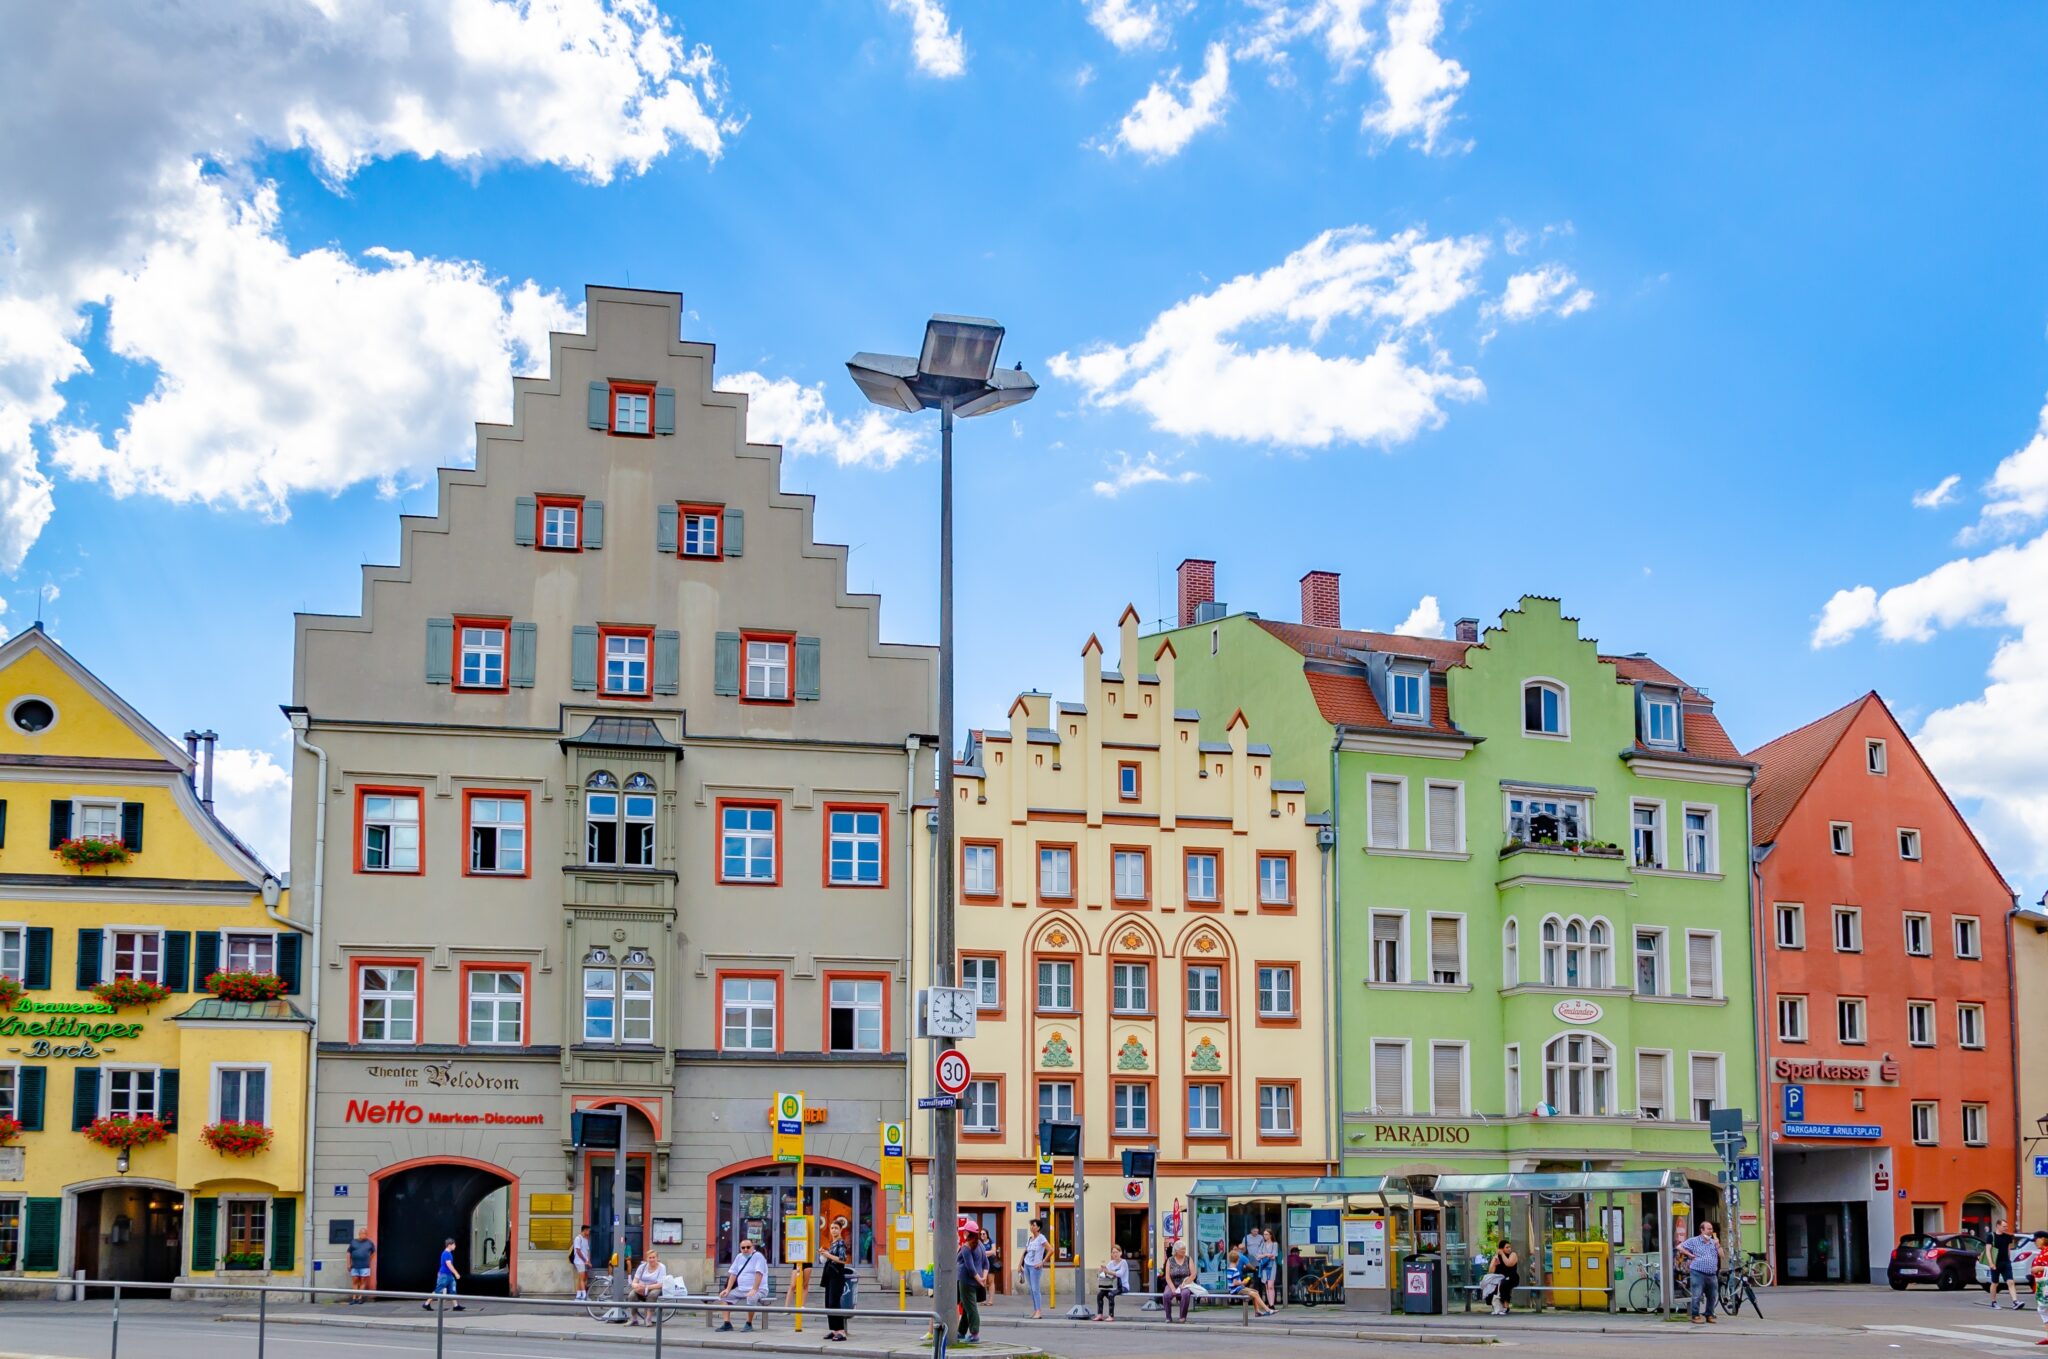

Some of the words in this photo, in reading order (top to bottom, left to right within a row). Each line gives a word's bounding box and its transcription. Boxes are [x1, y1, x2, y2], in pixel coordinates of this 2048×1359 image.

[13, 998, 116, 1014] Brauerei
[23, 1040, 101, 1058] Bock
[365, 1066, 418, 1078] Theater
[943, 1062, 963, 1081] 30
[1776, 1059, 1871, 1081] Sparkasse
[405, 1079, 418, 1088] im
[787, 1100, 793, 1113] H
[1789, 1092, 1799, 1108] P
[345, 1100, 424, 1124] Netto
[428, 1112, 544, 1125] Marken-Discount
[1375, 1125, 1470, 1144] PARADISO
[1787, 1125, 1831, 1135] PARKGARAGE
[1833, 1127, 1880, 1136] ARNULFSPLATZ
